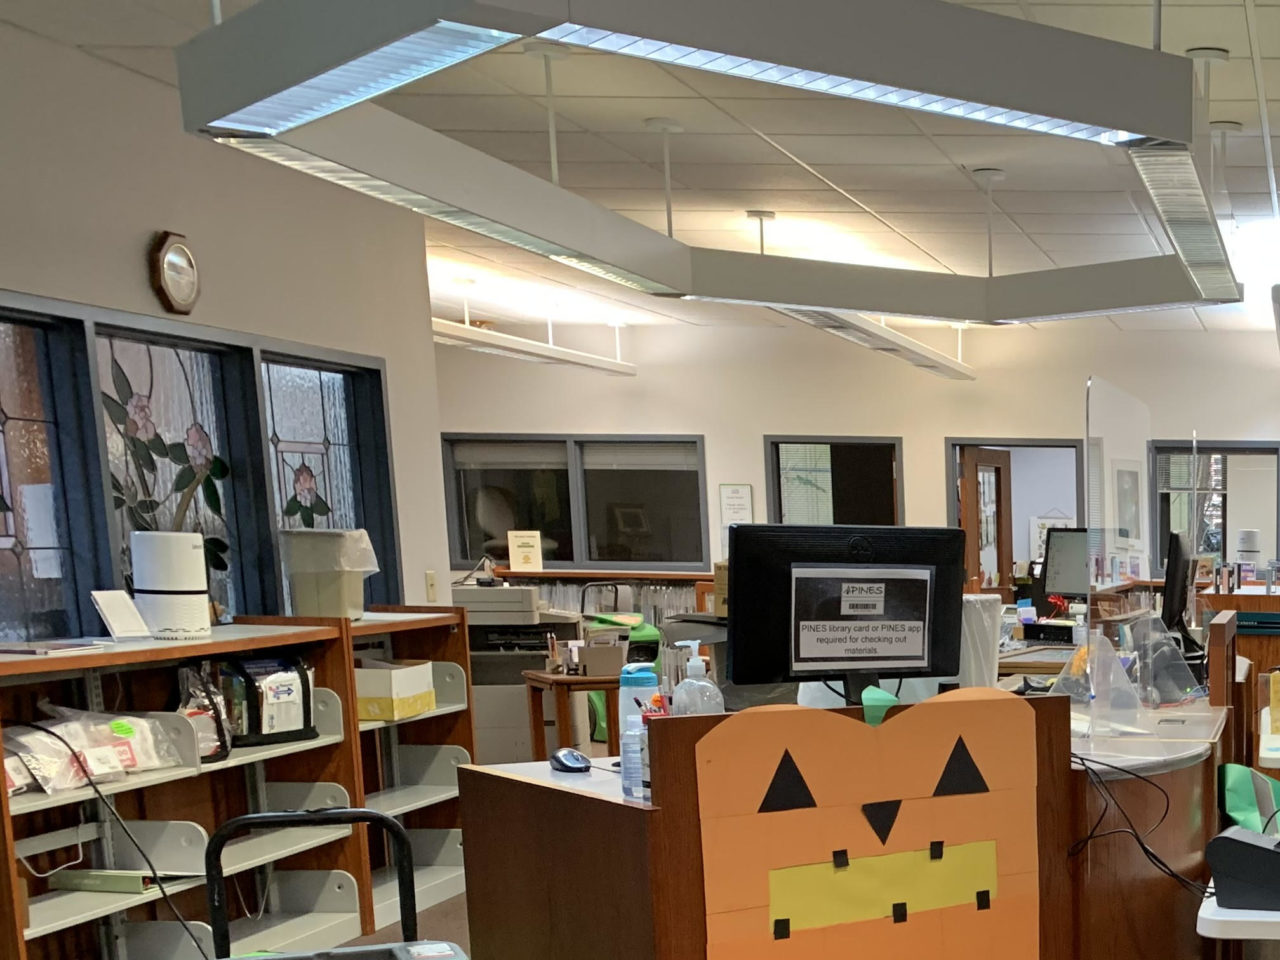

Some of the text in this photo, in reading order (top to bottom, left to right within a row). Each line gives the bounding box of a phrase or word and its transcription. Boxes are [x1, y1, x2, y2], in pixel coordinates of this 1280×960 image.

[850, 585, 884, 595] PINES
[801, 624, 827, 633] PINES
[828, 624, 851, 634] library
[853, 624, 870, 633] card
[881, 624, 906, 632] PINES
[907, 625, 922, 634] app
[816, 636, 907, 645] required for checking out
